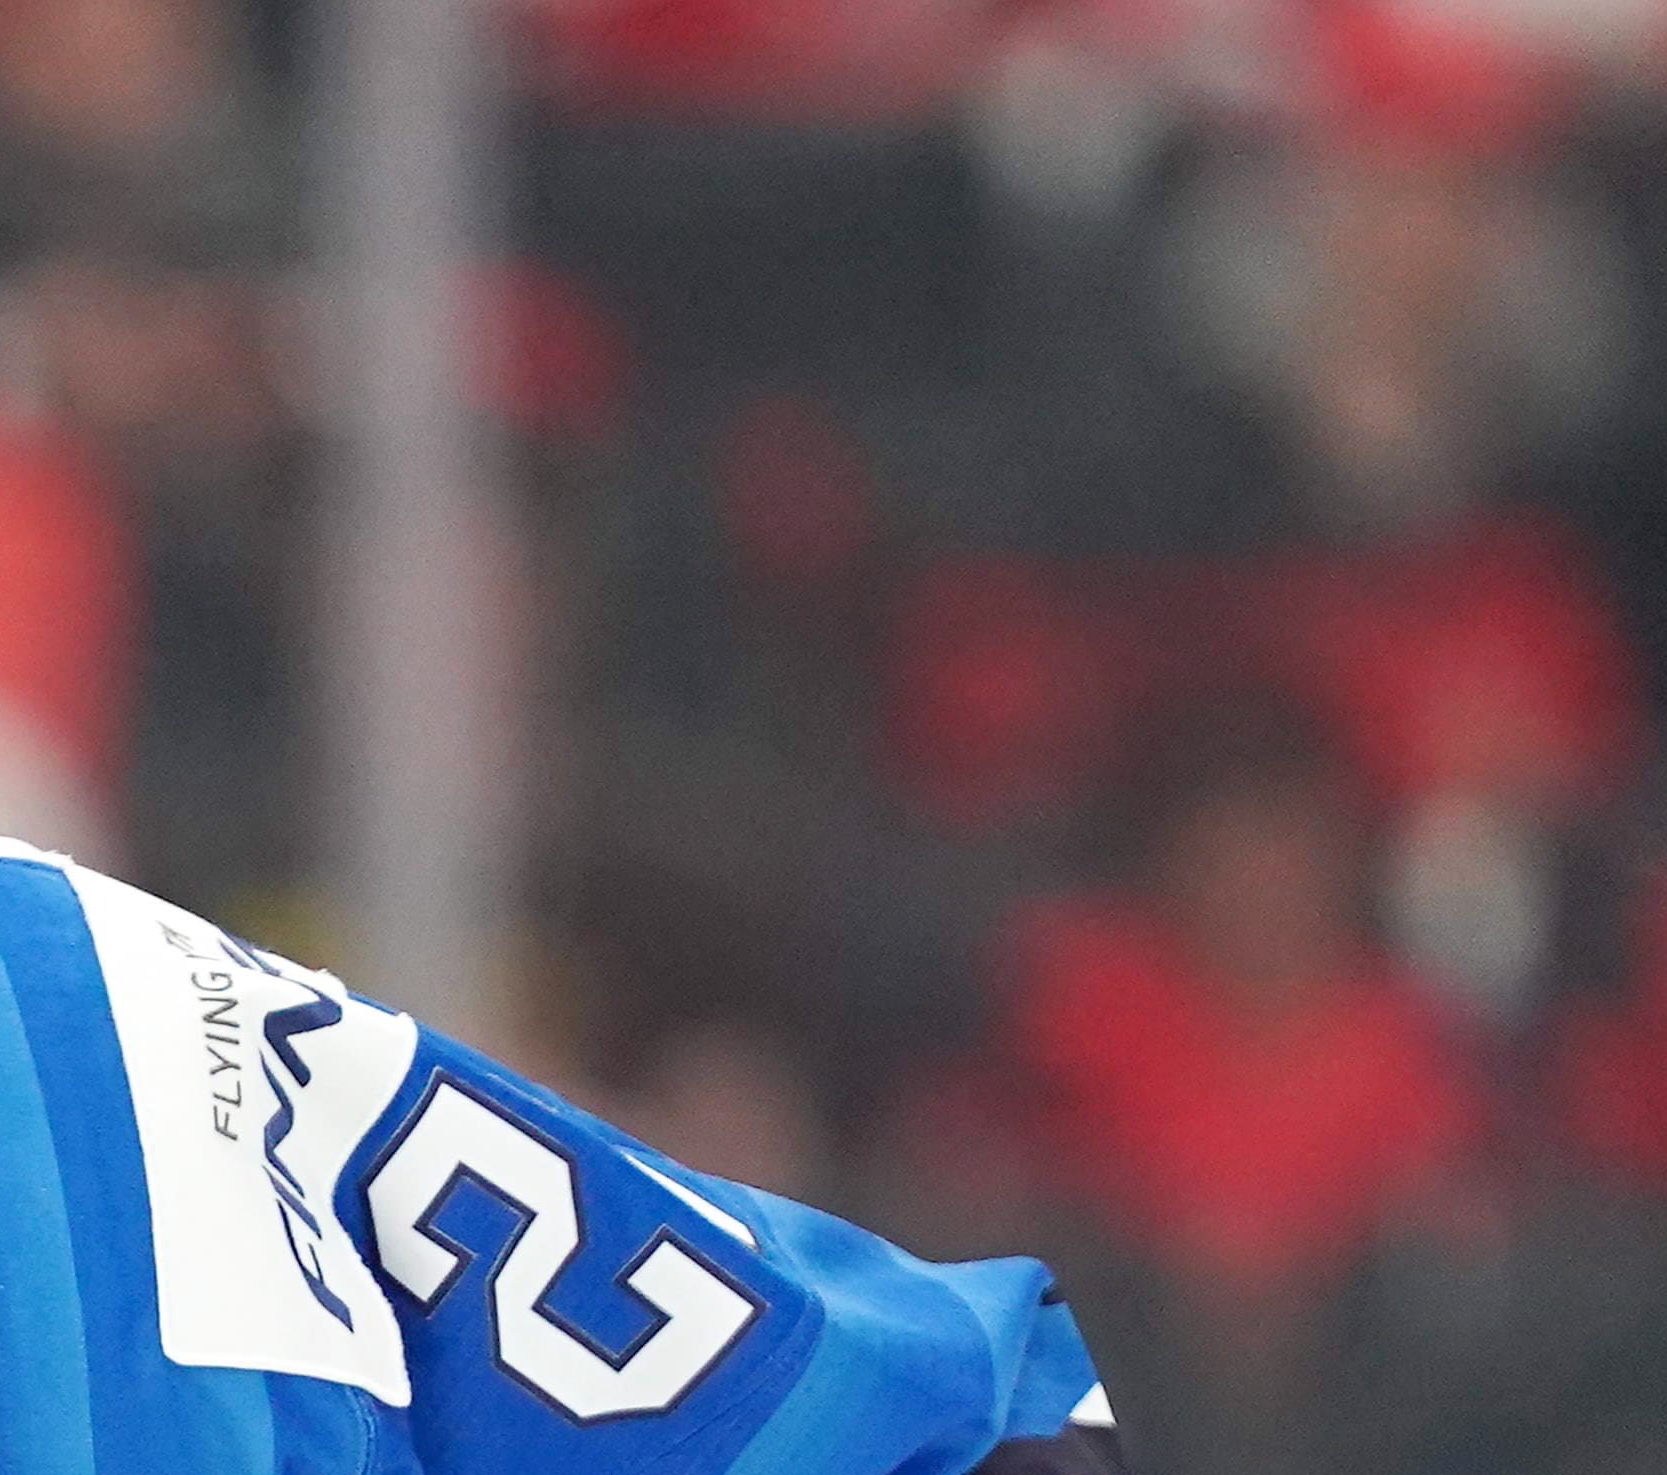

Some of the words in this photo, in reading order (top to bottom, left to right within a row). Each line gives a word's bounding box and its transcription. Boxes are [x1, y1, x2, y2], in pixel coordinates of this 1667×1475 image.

[190, 970, 242, 1142] FLYING
[219, 927, 355, 1334] FINN
[367, 1068, 769, 1428] 2
